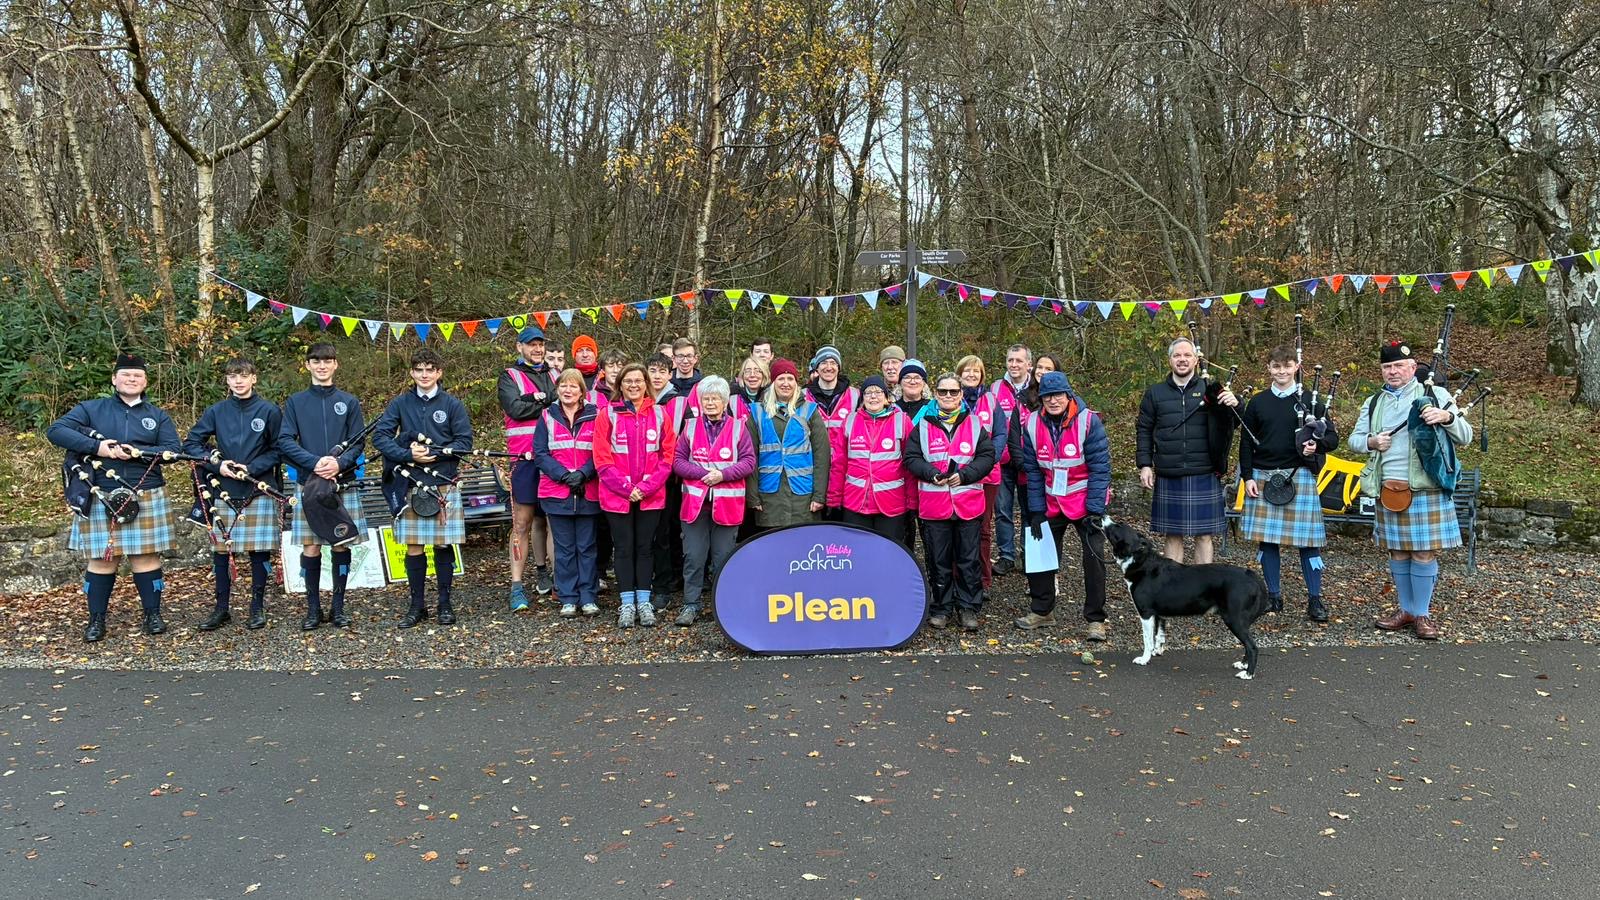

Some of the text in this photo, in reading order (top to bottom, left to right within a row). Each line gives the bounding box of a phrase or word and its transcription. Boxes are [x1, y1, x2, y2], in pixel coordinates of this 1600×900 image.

[826, 543, 851, 557] Vitality
[789, 551, 852, 575] parkrun
[768, 592, 875, 623] Plean
